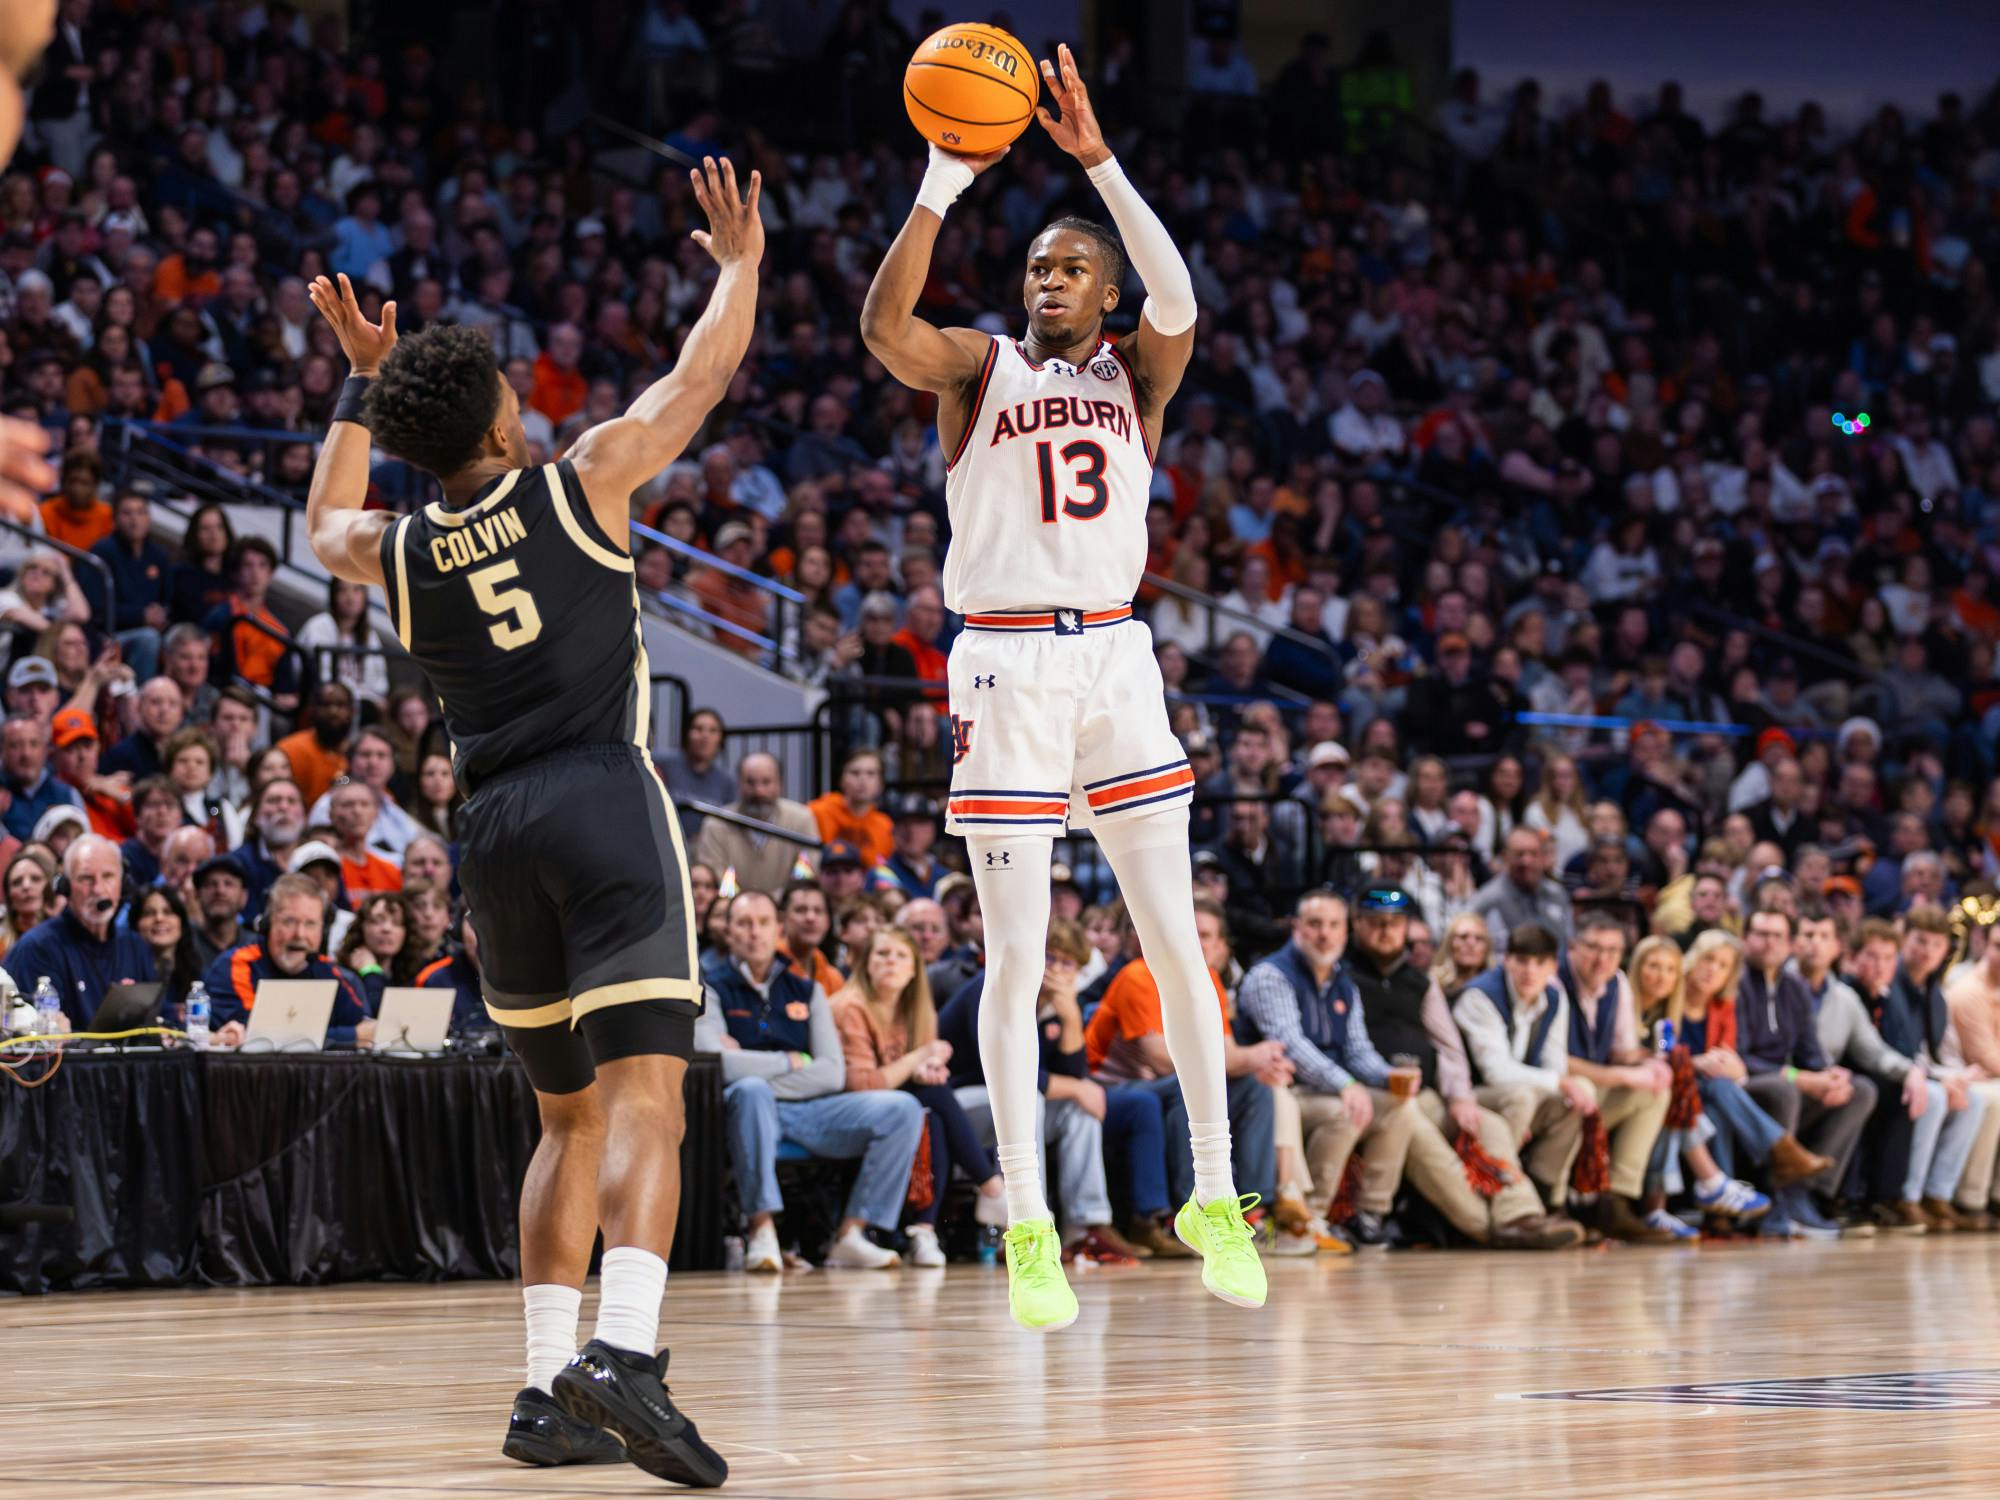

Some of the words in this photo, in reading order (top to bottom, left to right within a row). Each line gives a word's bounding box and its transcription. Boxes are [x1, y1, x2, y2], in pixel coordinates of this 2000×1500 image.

[935, 38, 1018, 78] Wilson
[1092, 361, 1119, 381] SEC
[990, 397, 1131, 448] AUBURN
[1036, 440, 1109, 523] 13
[431, 506, 528, 573] COLVIN
[466, 558, 542, 651] 5
